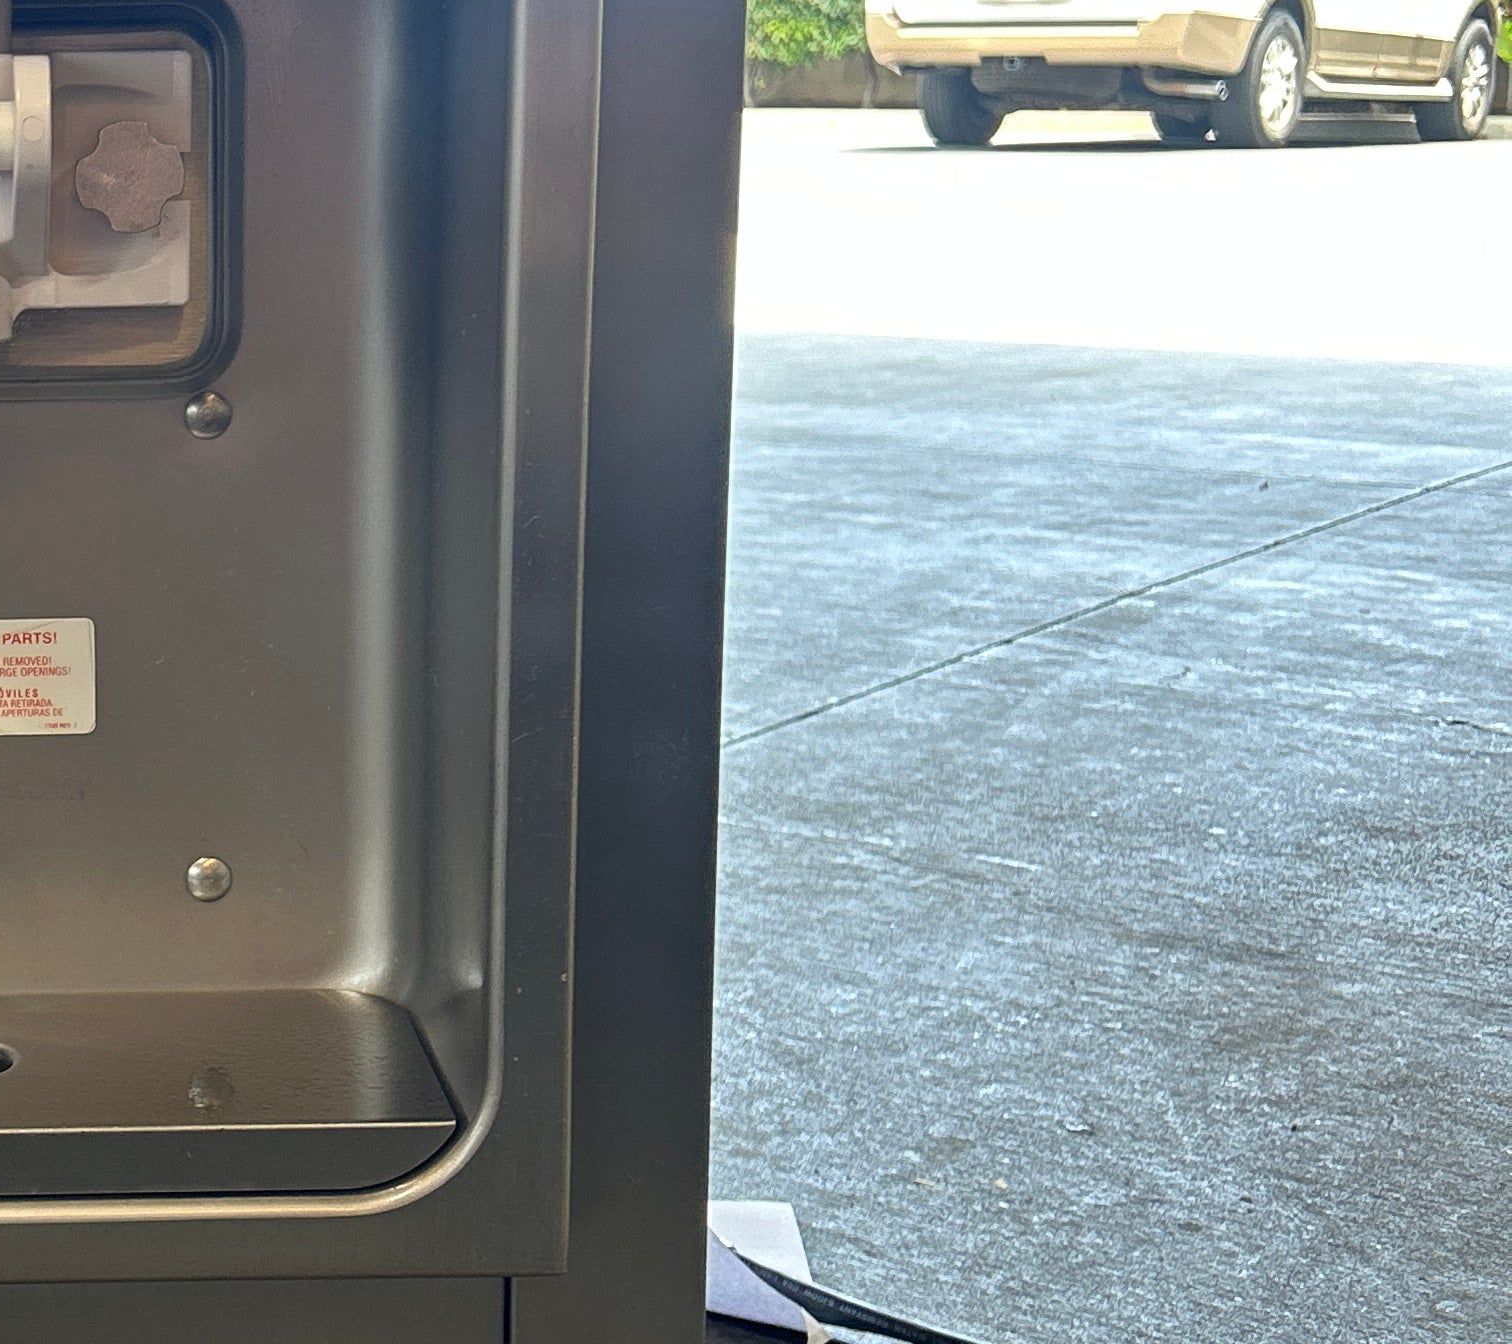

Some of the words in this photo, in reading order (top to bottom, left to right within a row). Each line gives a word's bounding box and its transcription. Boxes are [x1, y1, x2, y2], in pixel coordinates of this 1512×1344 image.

[2, 631, 58, 645] PARTS!
[3, 656, 52, 666] REMOVED!
[1, 707, 51, 717] APERTURAS
[52, 707, 63, 717] DE
